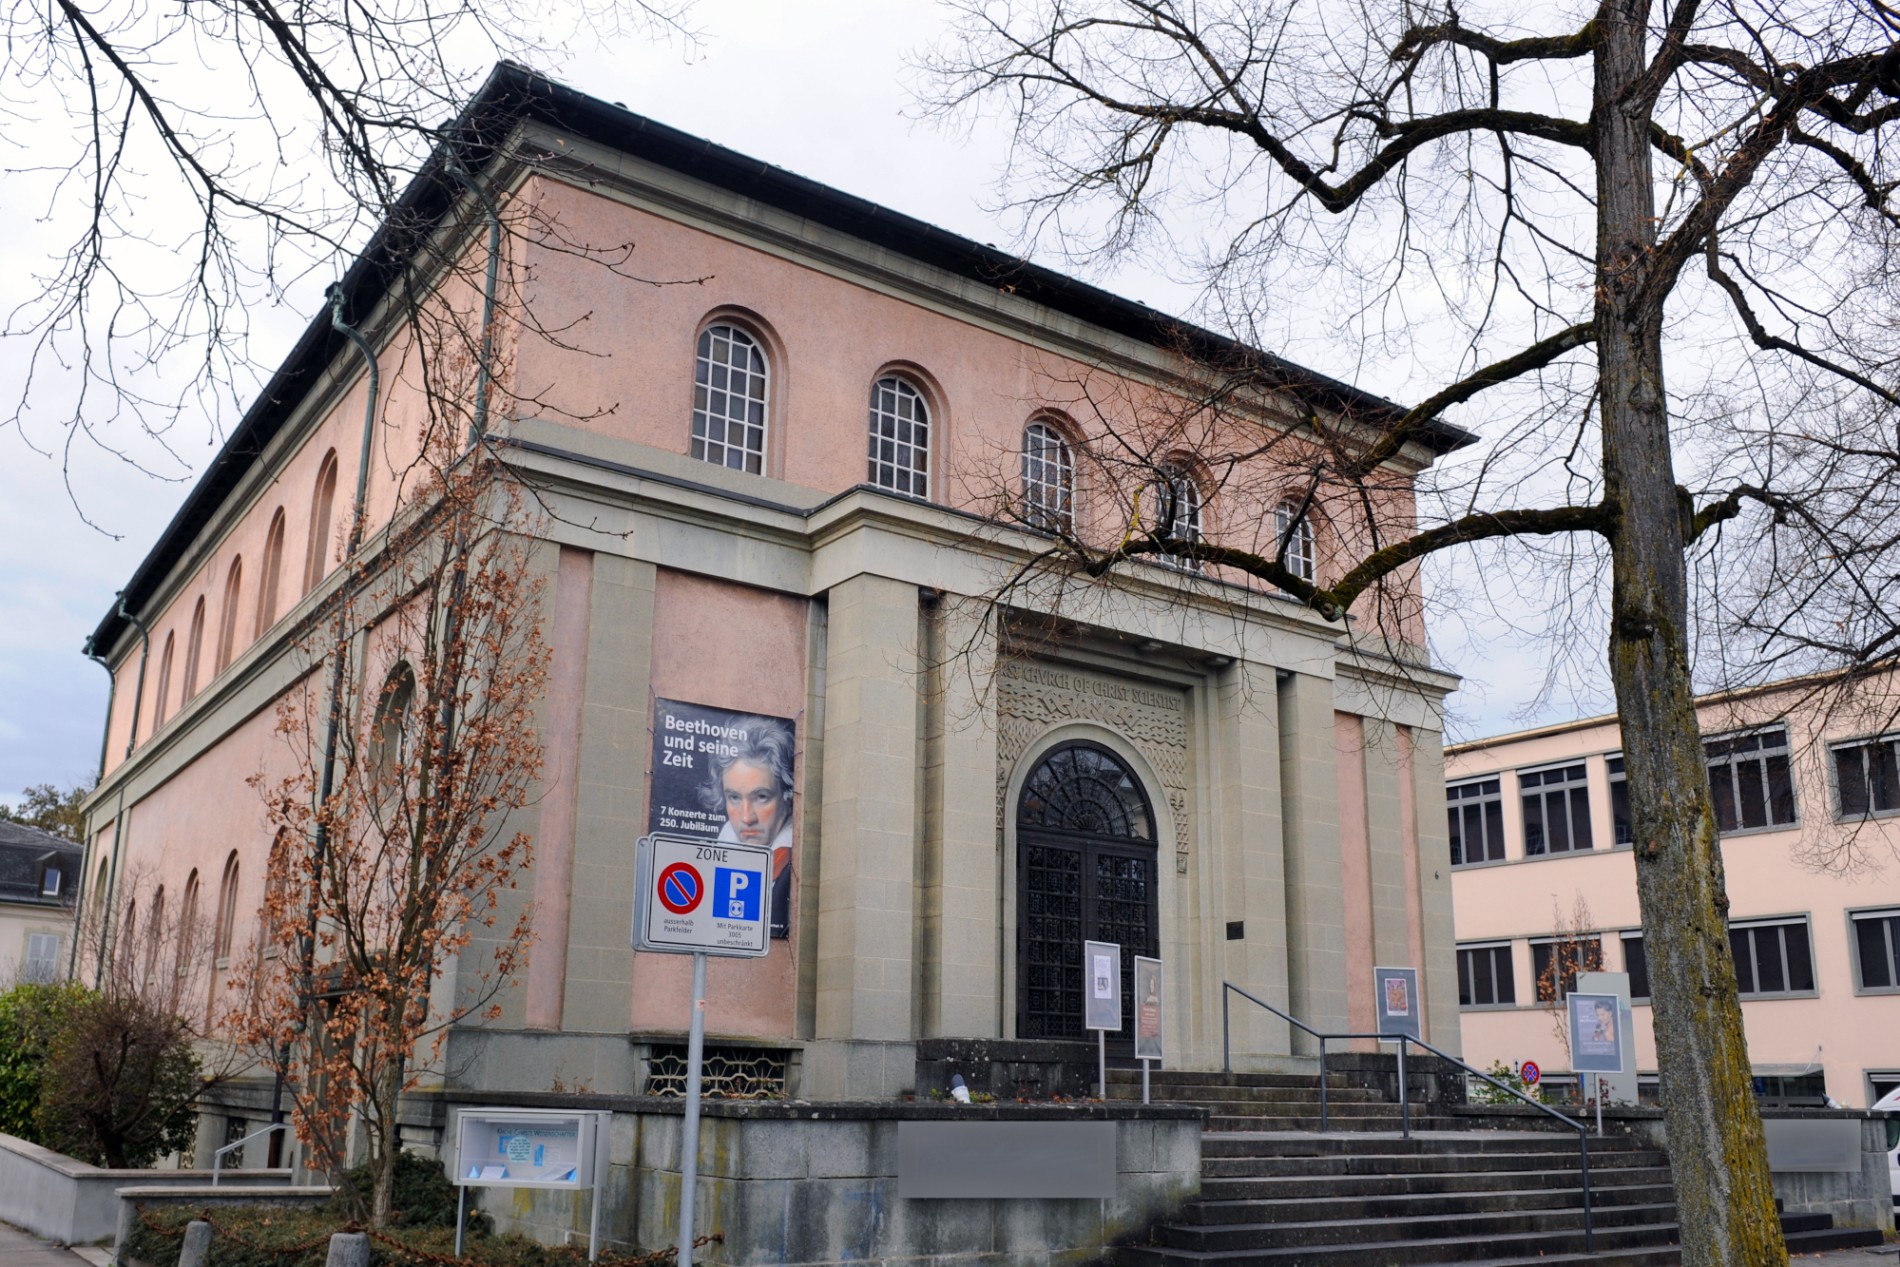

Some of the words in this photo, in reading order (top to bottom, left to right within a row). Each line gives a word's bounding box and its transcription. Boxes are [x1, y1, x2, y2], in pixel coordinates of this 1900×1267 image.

[1023, 667, 1070, 690] CHVRCH
[1073, 676, 1090, 694] OF
[1092, 680, 1130, 702] CHRIST
[1131, 688, 1181, 711] SCIENTIST
[665, 714, 748, 741] Beethoven
[664, 735, 694, 751] und
[698, 739, 739, 757] seine
[662, 750, 694, 768] Zeit
[660, 805, 667, 815] 7
[668, 807, 707, 821] Konzerte
[708, 813, 726, 823] zum
[659, 818, 679, 829] 250.
[680, 820, 720, 834] Jubiläum
[696, 847, 728, 863] ZONE
[729, 871, 749, 899] P
[663, 918, 694, 927] ausserhalb
[663, 925, 693, 934] Parkfelder
[727, 923, 753, 932] Parkkarte
[717, 939, 753, 948] unbeschränkt
